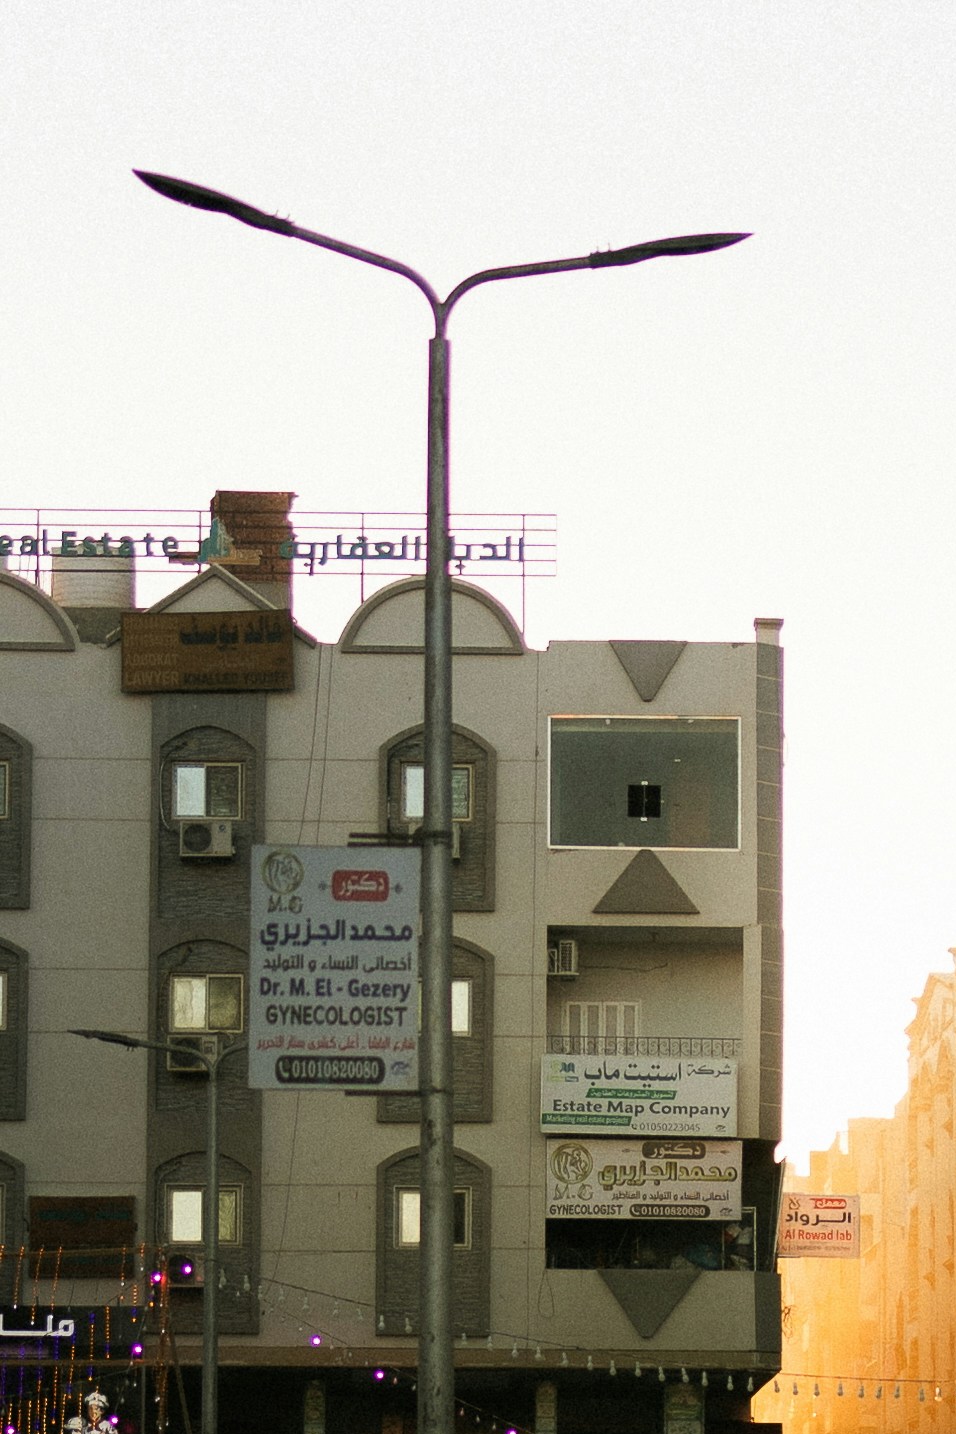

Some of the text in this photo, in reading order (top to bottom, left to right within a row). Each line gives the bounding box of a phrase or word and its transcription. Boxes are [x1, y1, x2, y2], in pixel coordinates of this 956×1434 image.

[0, 529, 180, 557] eal Estate
[278, 533, 422, 568] العقارية
[124, 670, 179, 686] LAWYER
[338, 873, 386, 897] دكتور
[260, 918, 413, 952] محمد الجزيري
[263, 954, 304, 972] التوليد
[308, 959, 317, 972] و
[320, 954, 359, 970] النساء
[259, 977, 285, 996] Dr.
[289, 977, 310, 996] M.
[316, 978, 332, 997] El
[347, 978, 410, 1003] Gezery
[265, 1004, 408, 1026] GYNECOLOGIST
[292, 1060, 379, 1079] 01010820080
[583, 1060, 732, 1088] شركة استيت ماب
[552, 1099, 730, 1119] Estate Map Company
[650, 1142, 702, 1159] دكتور
[598, 1160, 737, 1191] محمد الجزيري
[549, 1204, 623, 1217] GYNECOLOGIST
[640, 1205, 705, 1216] 01010820080
[785, 1210, 852, 1226] الرواد
[784, 1229, 852, 1241] Al Rowad lab
